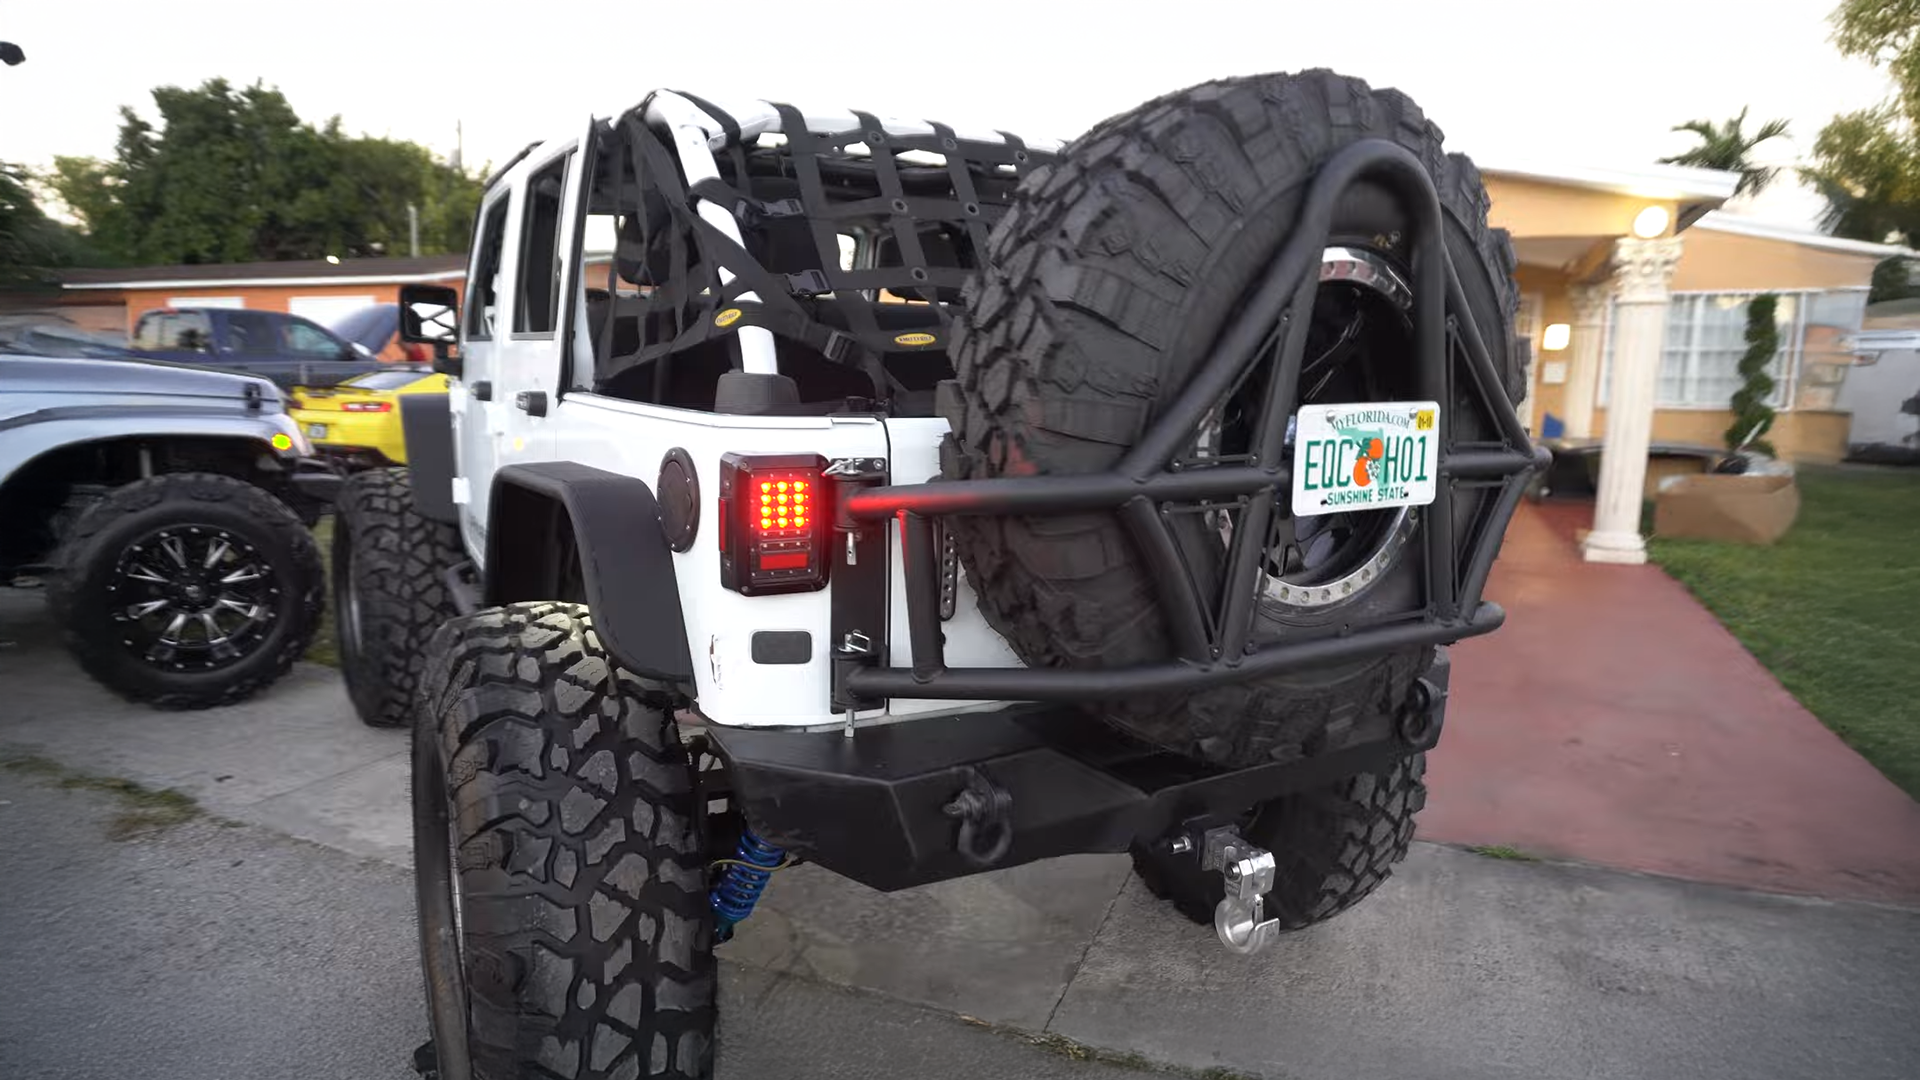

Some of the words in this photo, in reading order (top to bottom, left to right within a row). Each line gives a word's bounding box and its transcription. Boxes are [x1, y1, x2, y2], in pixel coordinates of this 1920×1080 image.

[1304, 439, 1354, 490] EQC
[1384, 435, 1428, 484] H01
[1327, 489, 1373, 505] SUNSHINE
[1378, 486, 1404, 501] STATE
